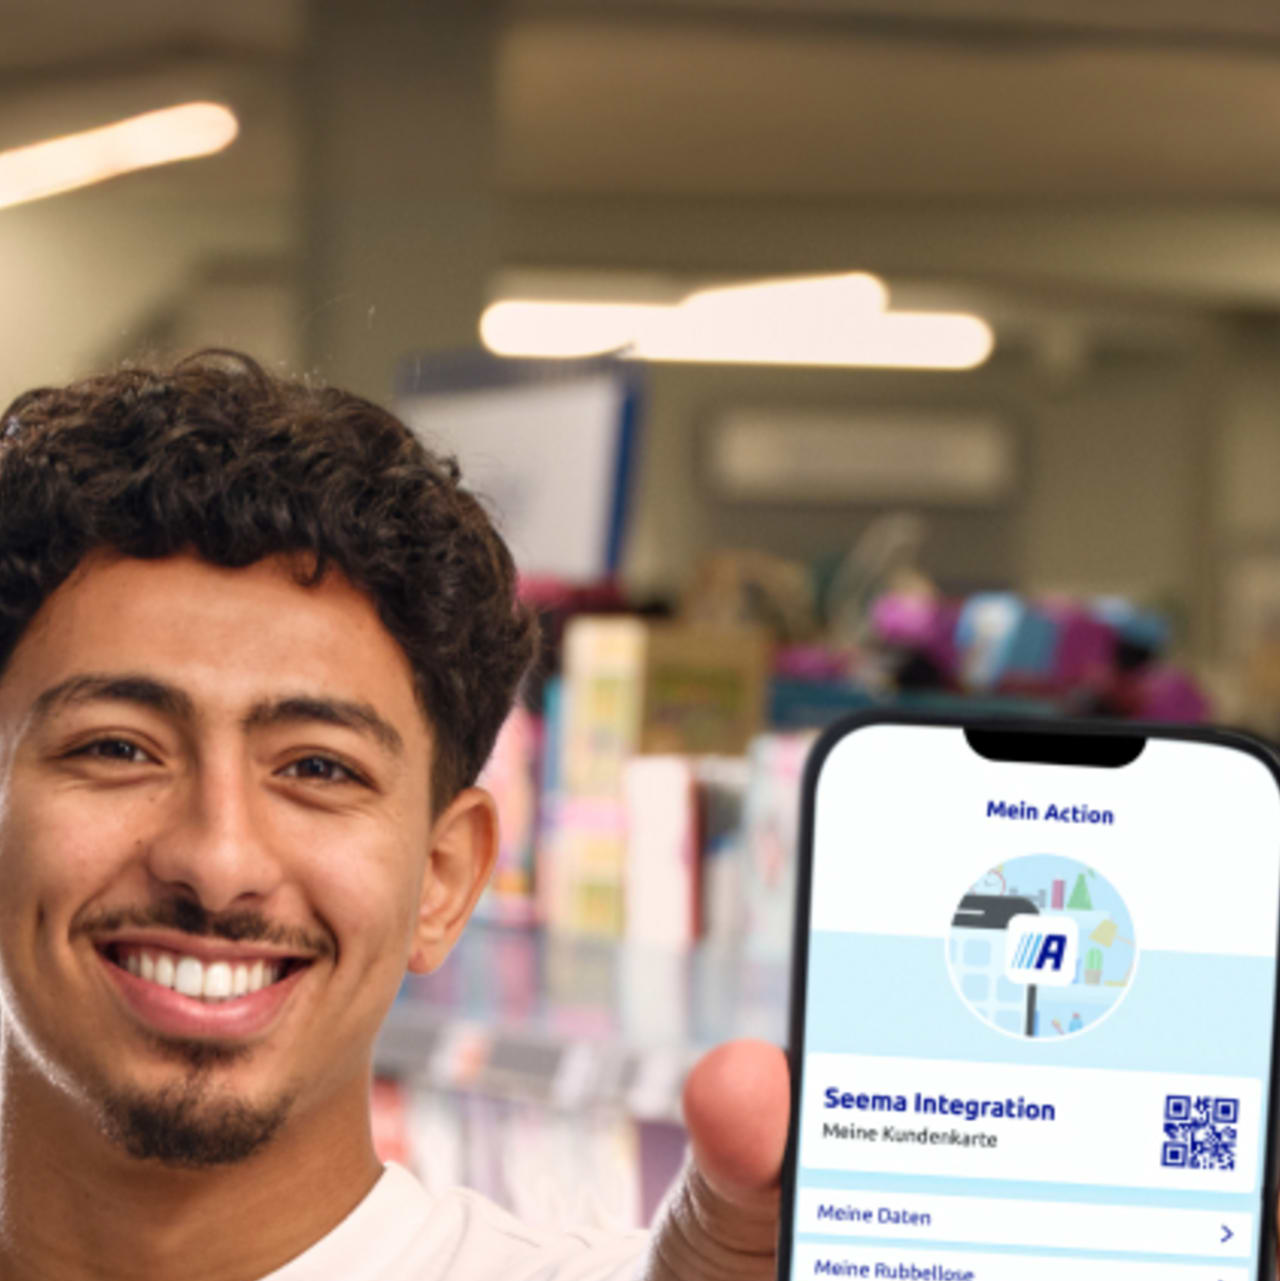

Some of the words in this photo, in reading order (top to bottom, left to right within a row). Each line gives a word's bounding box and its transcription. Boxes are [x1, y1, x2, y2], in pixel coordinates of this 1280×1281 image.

[986, 800, 1039, 821] Mein
[1043, 803, 1115, 825] Action
[823, 1086, 908, 1113] Seema
[914, 1092, 1056, 1122] Integration
[822, 1122, 879, 1142] Meine
[881, 1126, 998, 1150] Kundenkarte
[816, 1203, 874, 1223] Meine
[877, 1207, 932, 1226] Daten
[813, 1259, 871, 1279] Meine
